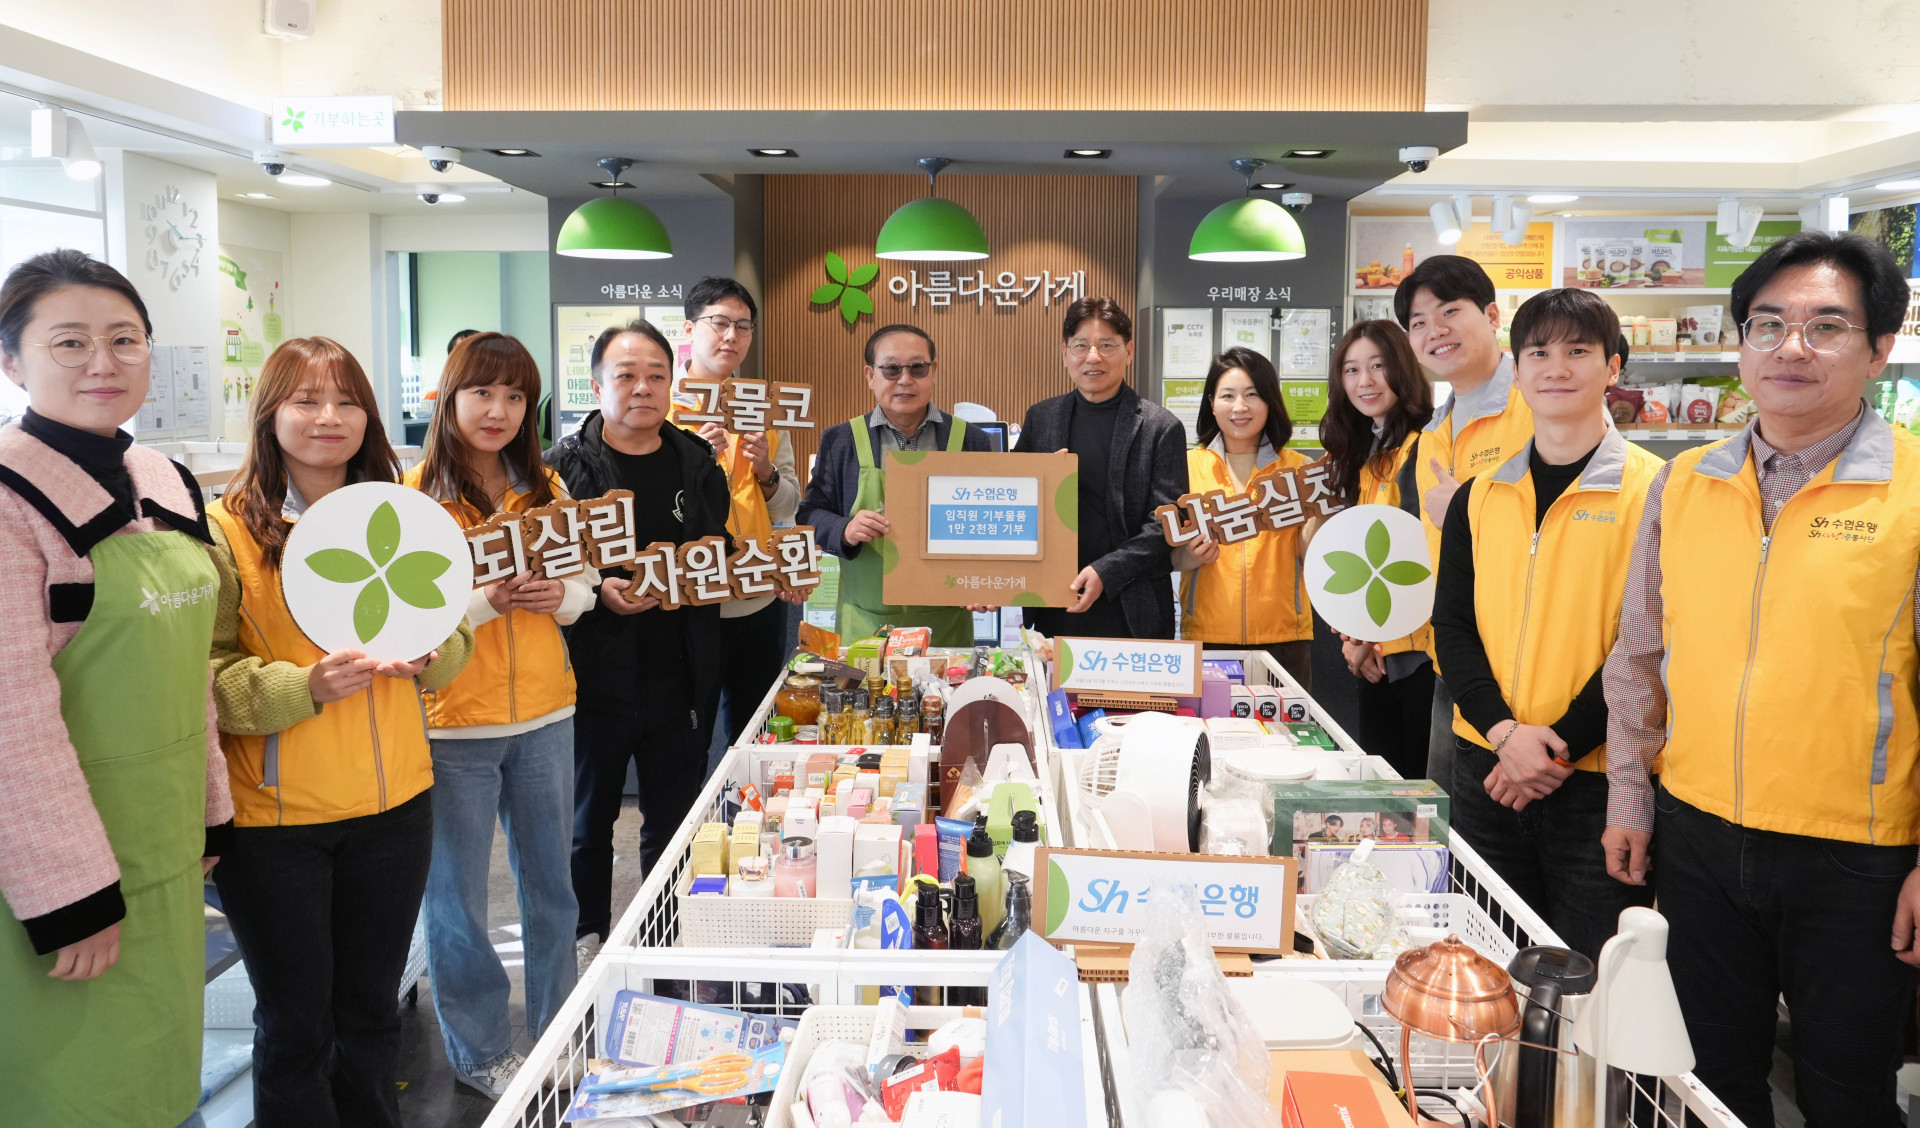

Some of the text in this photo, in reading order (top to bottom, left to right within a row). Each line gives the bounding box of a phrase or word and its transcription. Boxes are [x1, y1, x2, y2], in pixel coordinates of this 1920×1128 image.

[312, 110, 386, 128] 기부하는곳
[1505, 268, 1544, 280] 공익상품
[600, 284, 683, 299] 아름다운 소식
[888, 269, 1085, 307] 아름다운가게
[1207, 286, 1291, 302] 우리매장 소식
[567, 378, 592, 391] 아름
[1289, 387, 1319, 397] 반품안내
[678, 380, 815, 432] 그물코
[952, 487, 1018, 501] Sh 수협은행
[1162, 462, 1346, 544] 나눔실천
[945, 509, 1027, 522] 임직원 기부물품
[1572, 510, 1589, 521] Sh
[948, 523, 1025, 535] 1만 2천점 기부
[1810, 516, 1878, 533] Sh 수협은행
[472, 496, 635, 586] 되살림
[634, 530, 822, 605] 자원순환
[956, 576, 1027, 590] 아름다운가게
[160, 582, 215, 610] 아름다운가게
[1078, 650, 1182, 674] Sh 수협은행
[1077, 878, 1130, 914] Sh
[1072, 925, 1101, 934] 아름다운
[1103, 927, 1124, 936] 지구를
[1127, 928, 1144, 937] 가꾸
